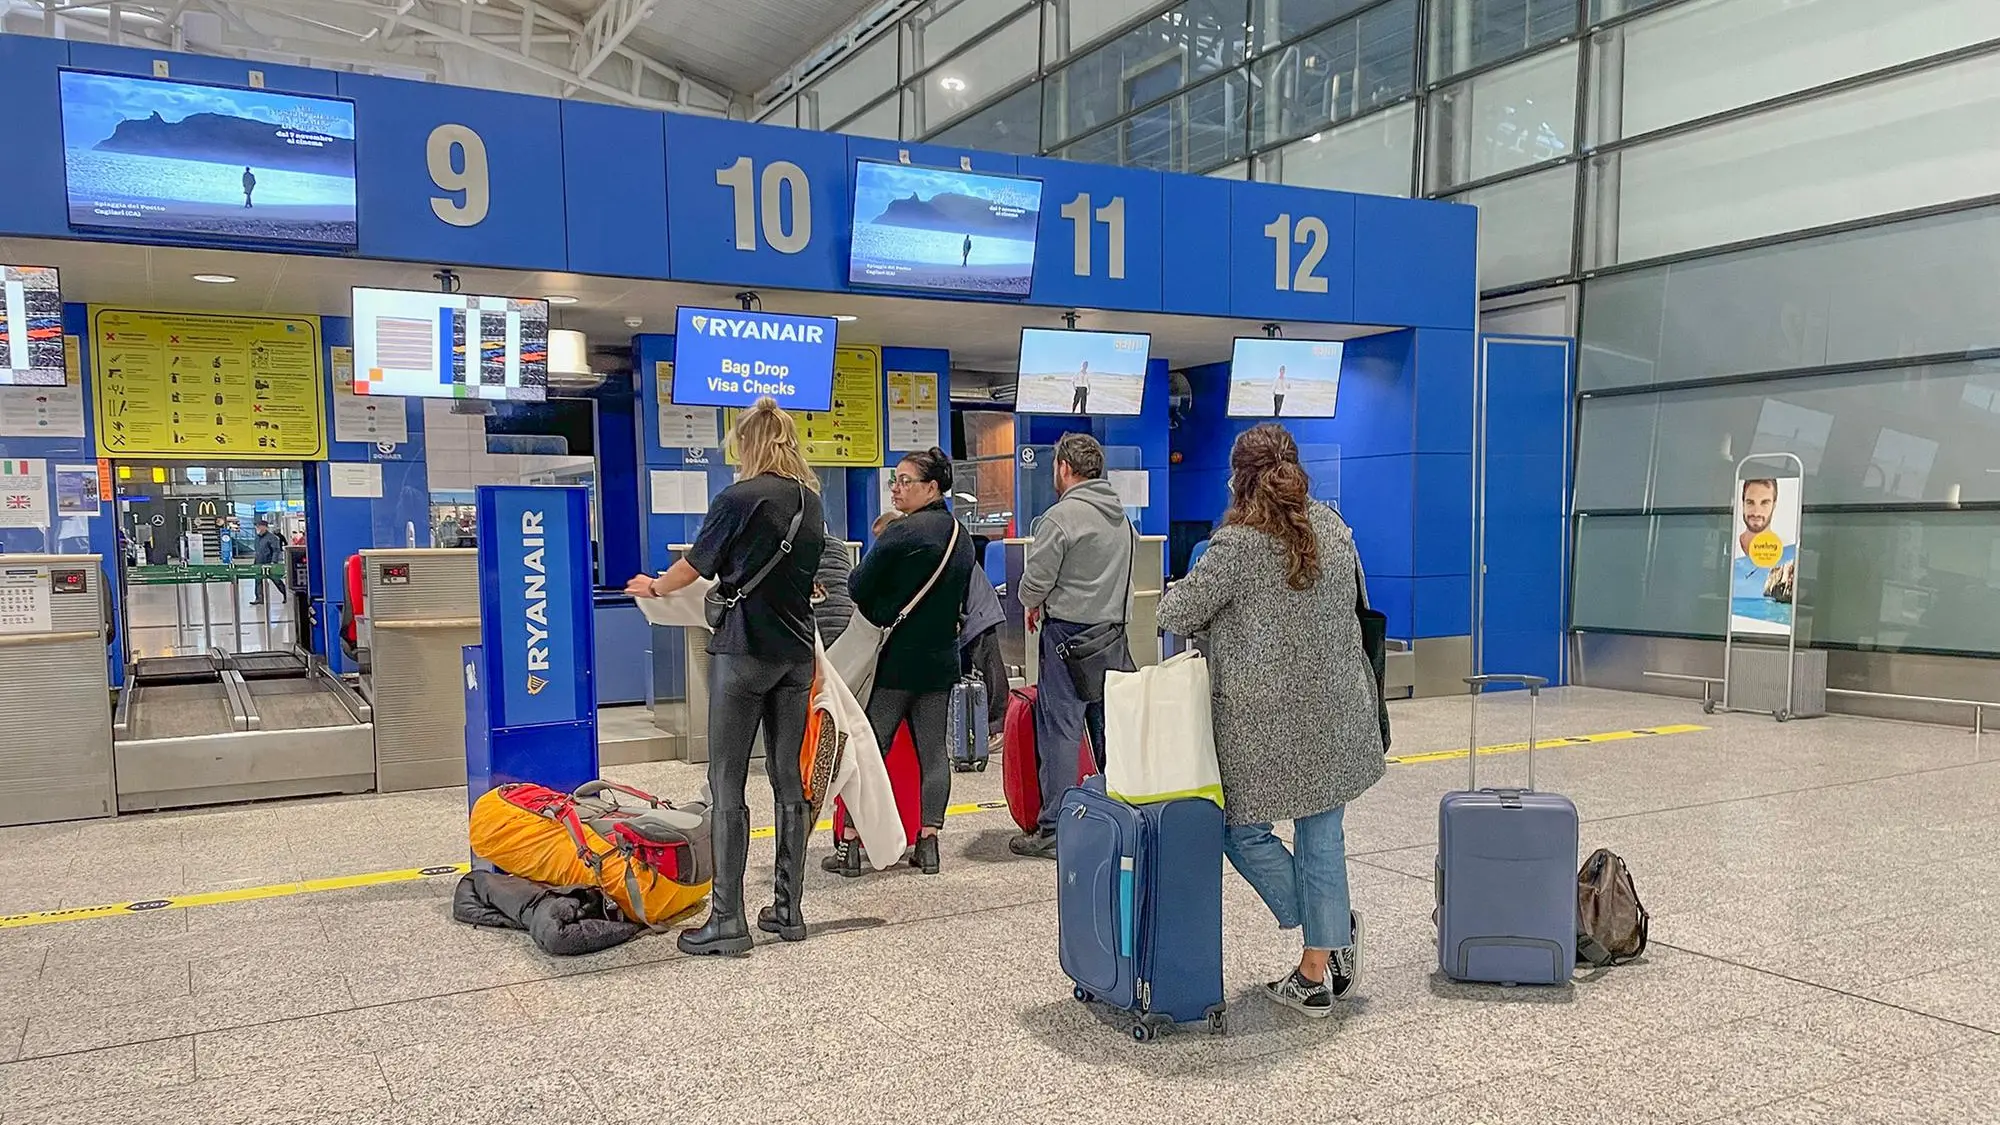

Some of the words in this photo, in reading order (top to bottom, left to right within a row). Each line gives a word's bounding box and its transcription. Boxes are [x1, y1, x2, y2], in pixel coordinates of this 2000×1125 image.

[295, 139, 324, 147] cinema
[427, 124, 489, 226] 9
[716, 156, 811, 254] 10
[1061, 193, 1125, 279] 11
[1265, 213, 1329, 294] 12
[709, 317, 824, 344] RYANAIR
[721, 359, 750, 377] Bag
[754, 361, 789, 379] Drop
[707, 377, 739, 393] Visa
[743, 379, 796, 396] Checks
[522, 510, 550, 671] RYANAIR
